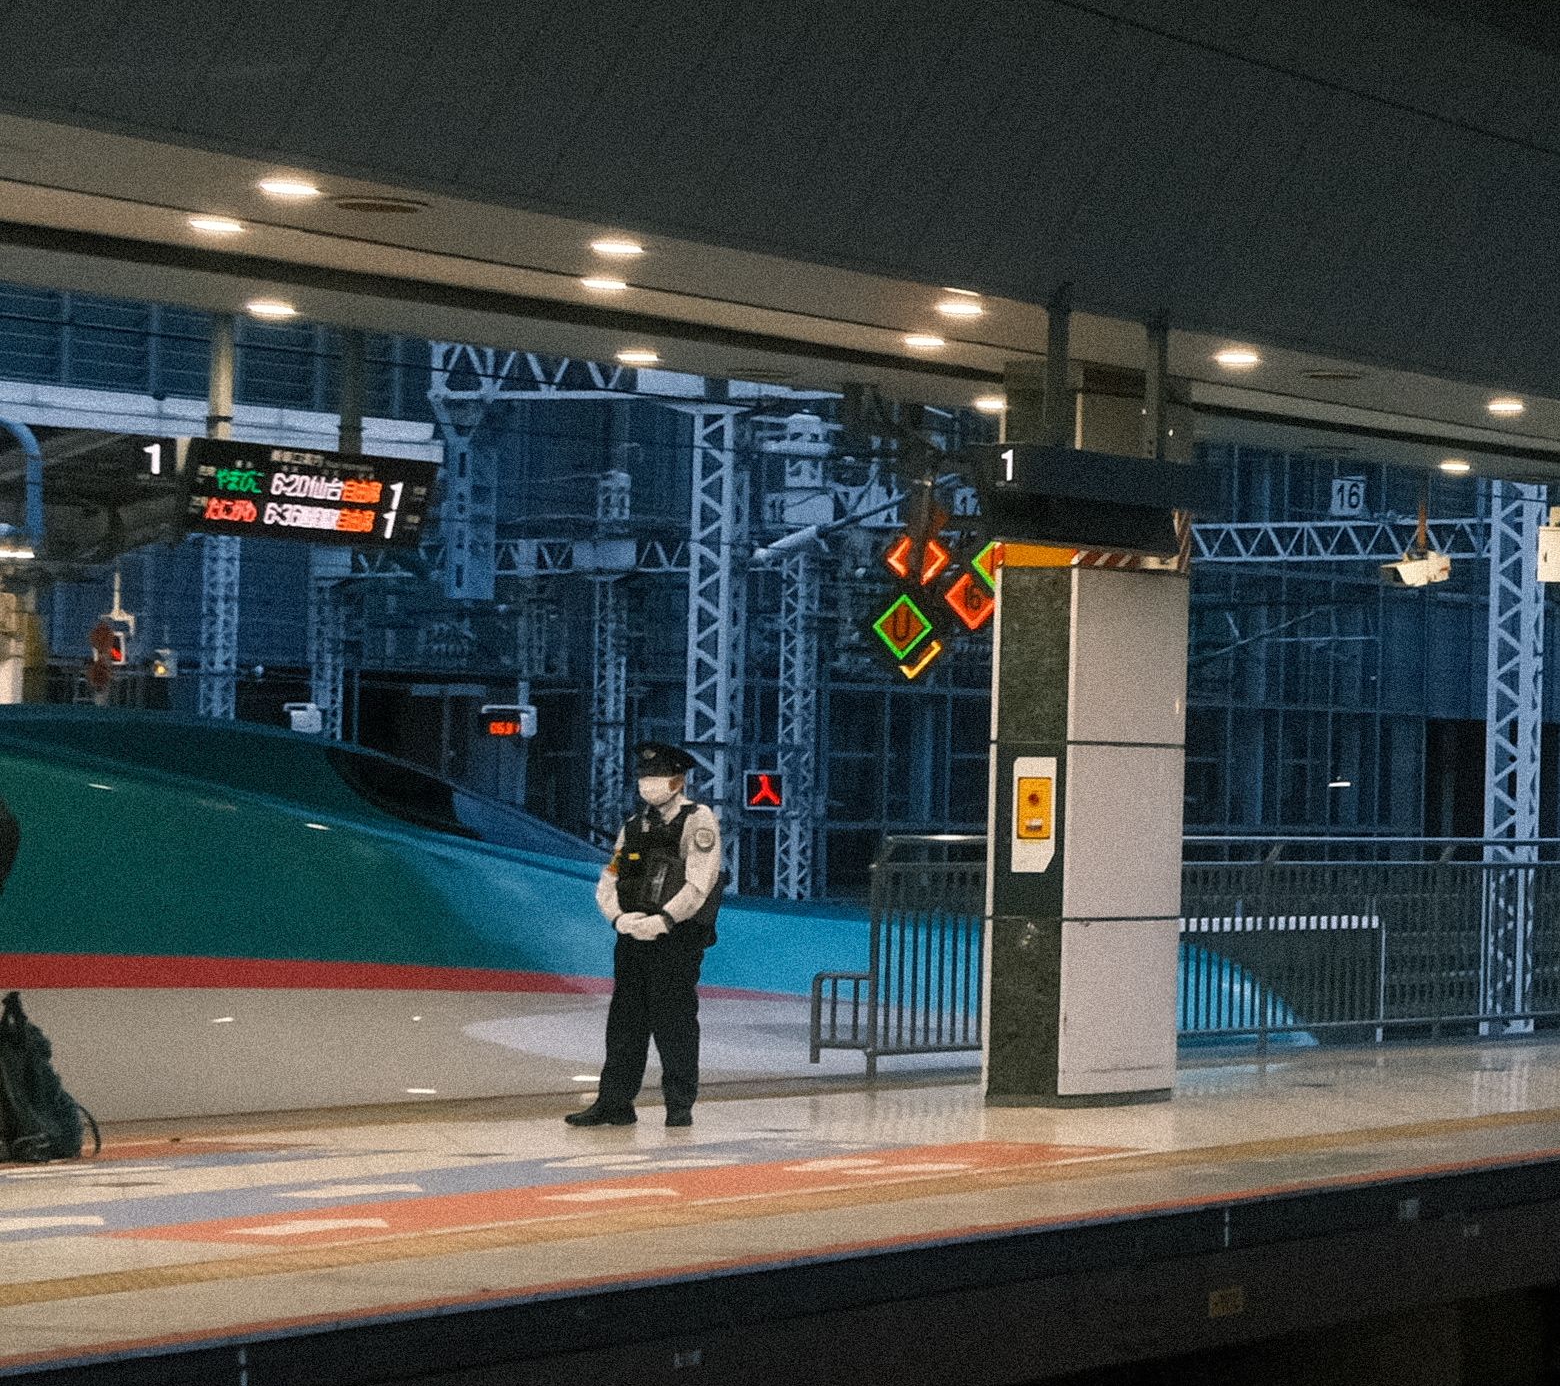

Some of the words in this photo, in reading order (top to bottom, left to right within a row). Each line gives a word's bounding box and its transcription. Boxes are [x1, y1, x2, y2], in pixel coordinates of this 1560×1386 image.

[143, 443, 161, 475] 1
[1001, 449, 1013, 481] 1
[390, 481, 404, 510] 1
[1338, 483, 1360, 509] 16
[383, 510, 396, 539] 1
